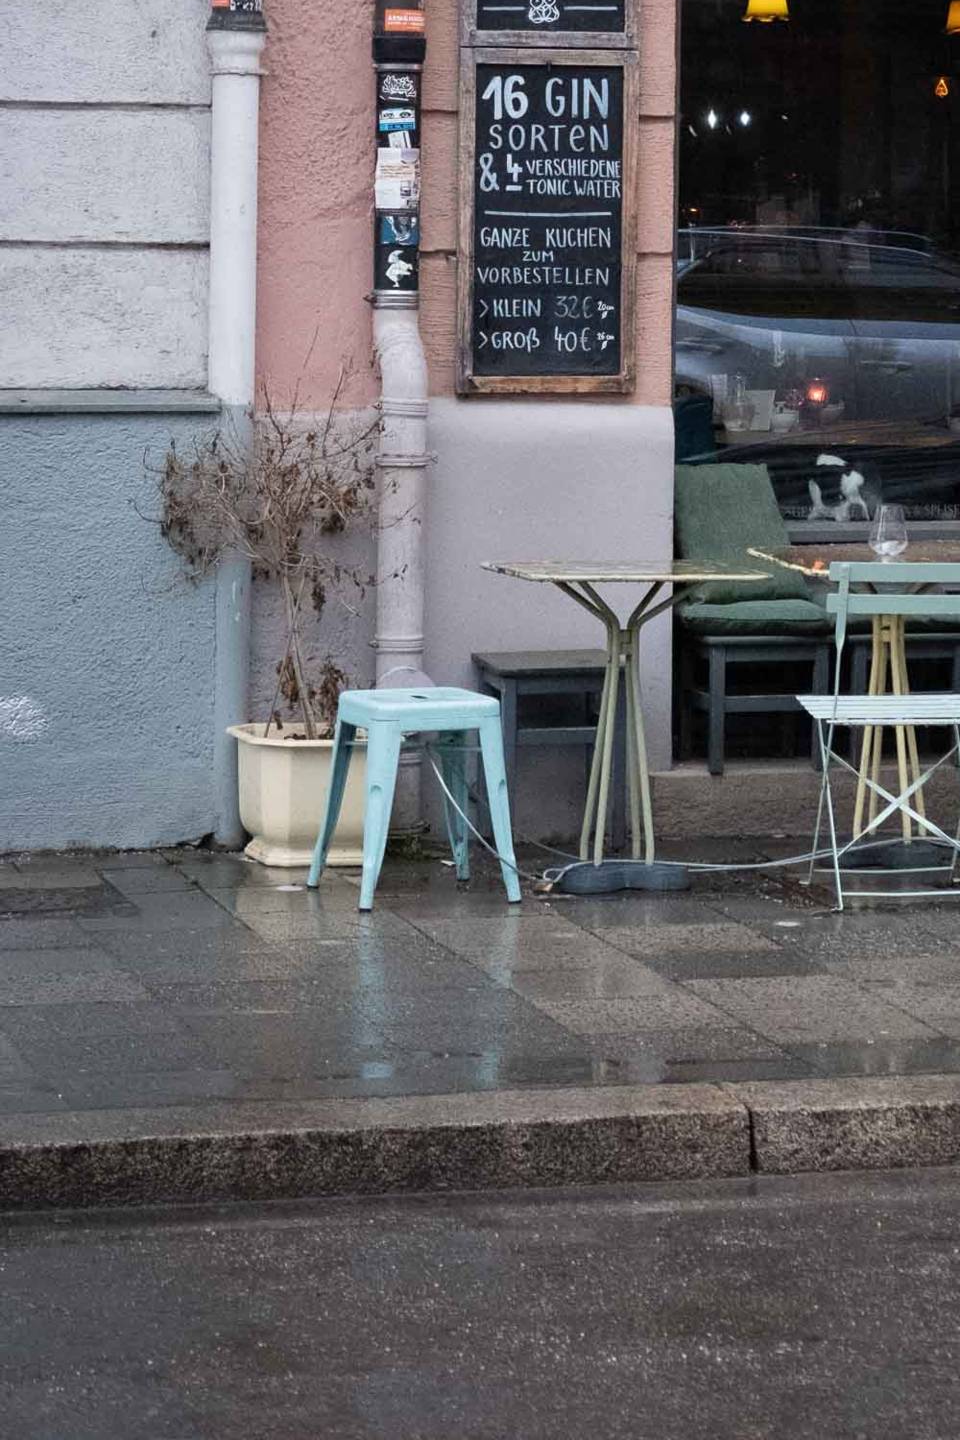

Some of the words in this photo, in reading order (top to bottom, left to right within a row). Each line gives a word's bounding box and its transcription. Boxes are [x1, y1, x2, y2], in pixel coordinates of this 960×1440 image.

[482, 75, 529, 120] 16
[545, 77, 609, 120] GIN
[479, 152, 500, 192] &
[506, 154, 523, 191] 4
[526, 159, 621, 179] VERSCHIEDENE
[526, 179, 572, 197] TONIC
[574, 179, 621, 198] WATER
[480, 227, 530, 248] GANZE
[546, 227, 612, 249] KUCHEN
[523, 251, 554, 262] ZUM
[477, 267, 609, 286] VORBESTELLEN
[493, 298, 541, 318] KLEIN
[554, 295, 593, 319] 32€
[554, 327, 592, 352] 40€
